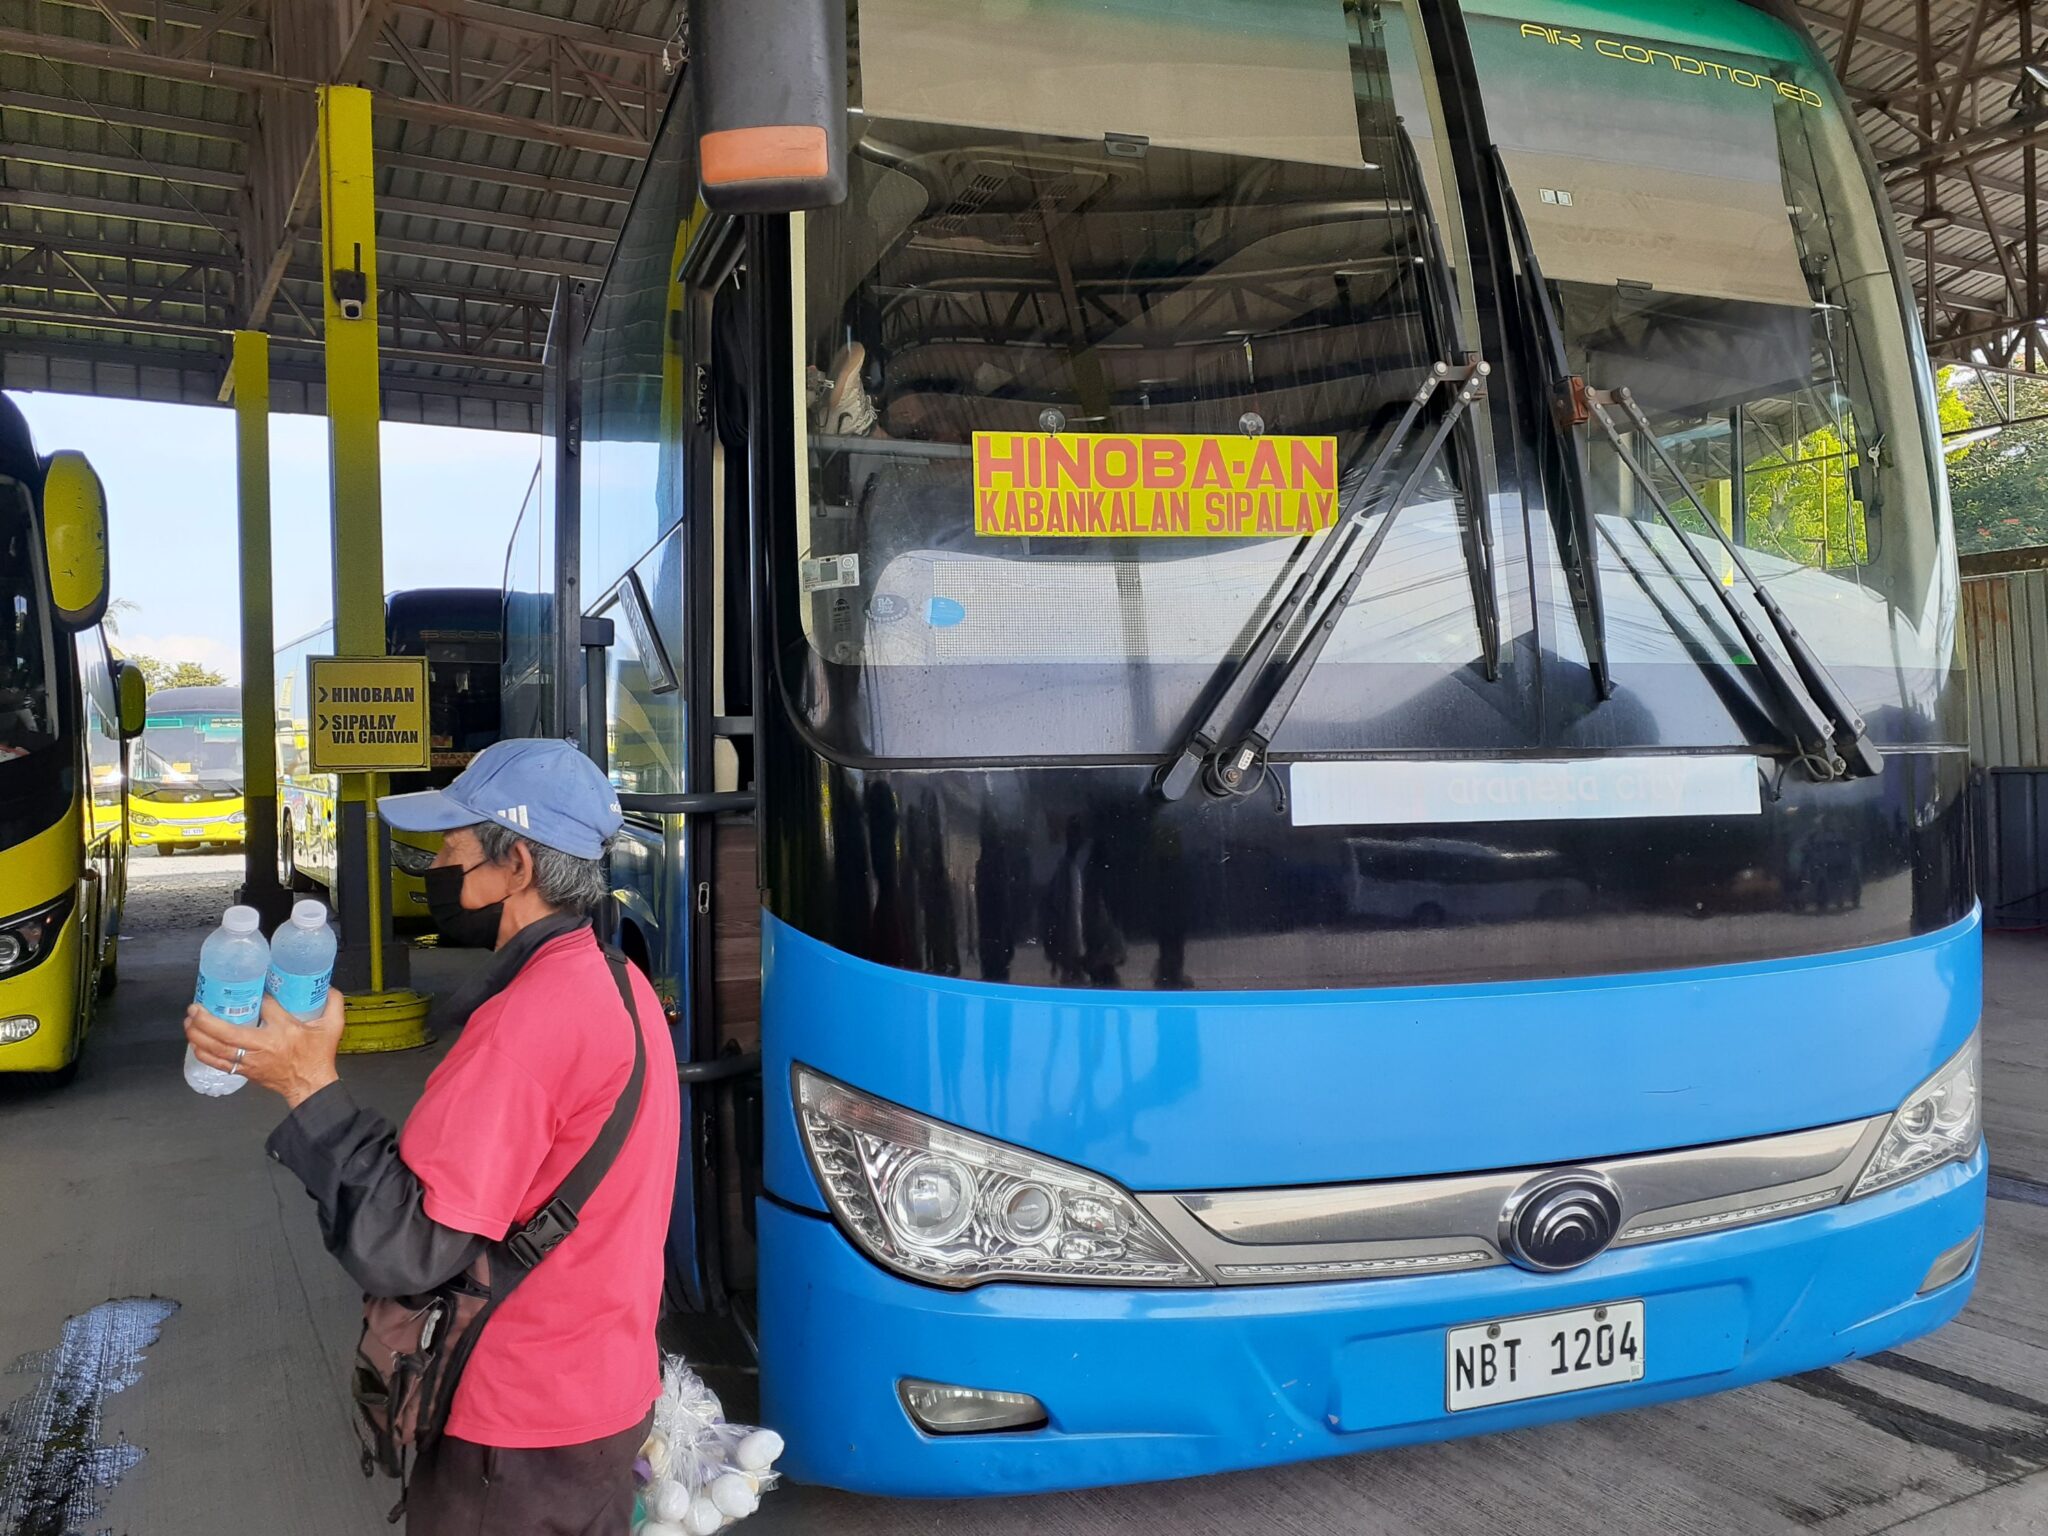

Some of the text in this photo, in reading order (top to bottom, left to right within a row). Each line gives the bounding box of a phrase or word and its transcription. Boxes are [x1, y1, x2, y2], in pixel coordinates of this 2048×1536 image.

[1519, 22, 1823, 109] AIR CONDITIONED
[977, 434, 1337, 490] HINOBA-AN
[979, 490, 1335, 534] KABANKALAN SIPALAY
[331, 687, 415, 703] HINOBAAN
[331, 714, 397, 731] SIPALAY
[331, 731, 356, 744] VIA
[358, 731, 419, 744] CAUAYAN
[1447, 763, 1687, 806] araneta city
[1455, 1320, 1638, 1392] NBT 1204
